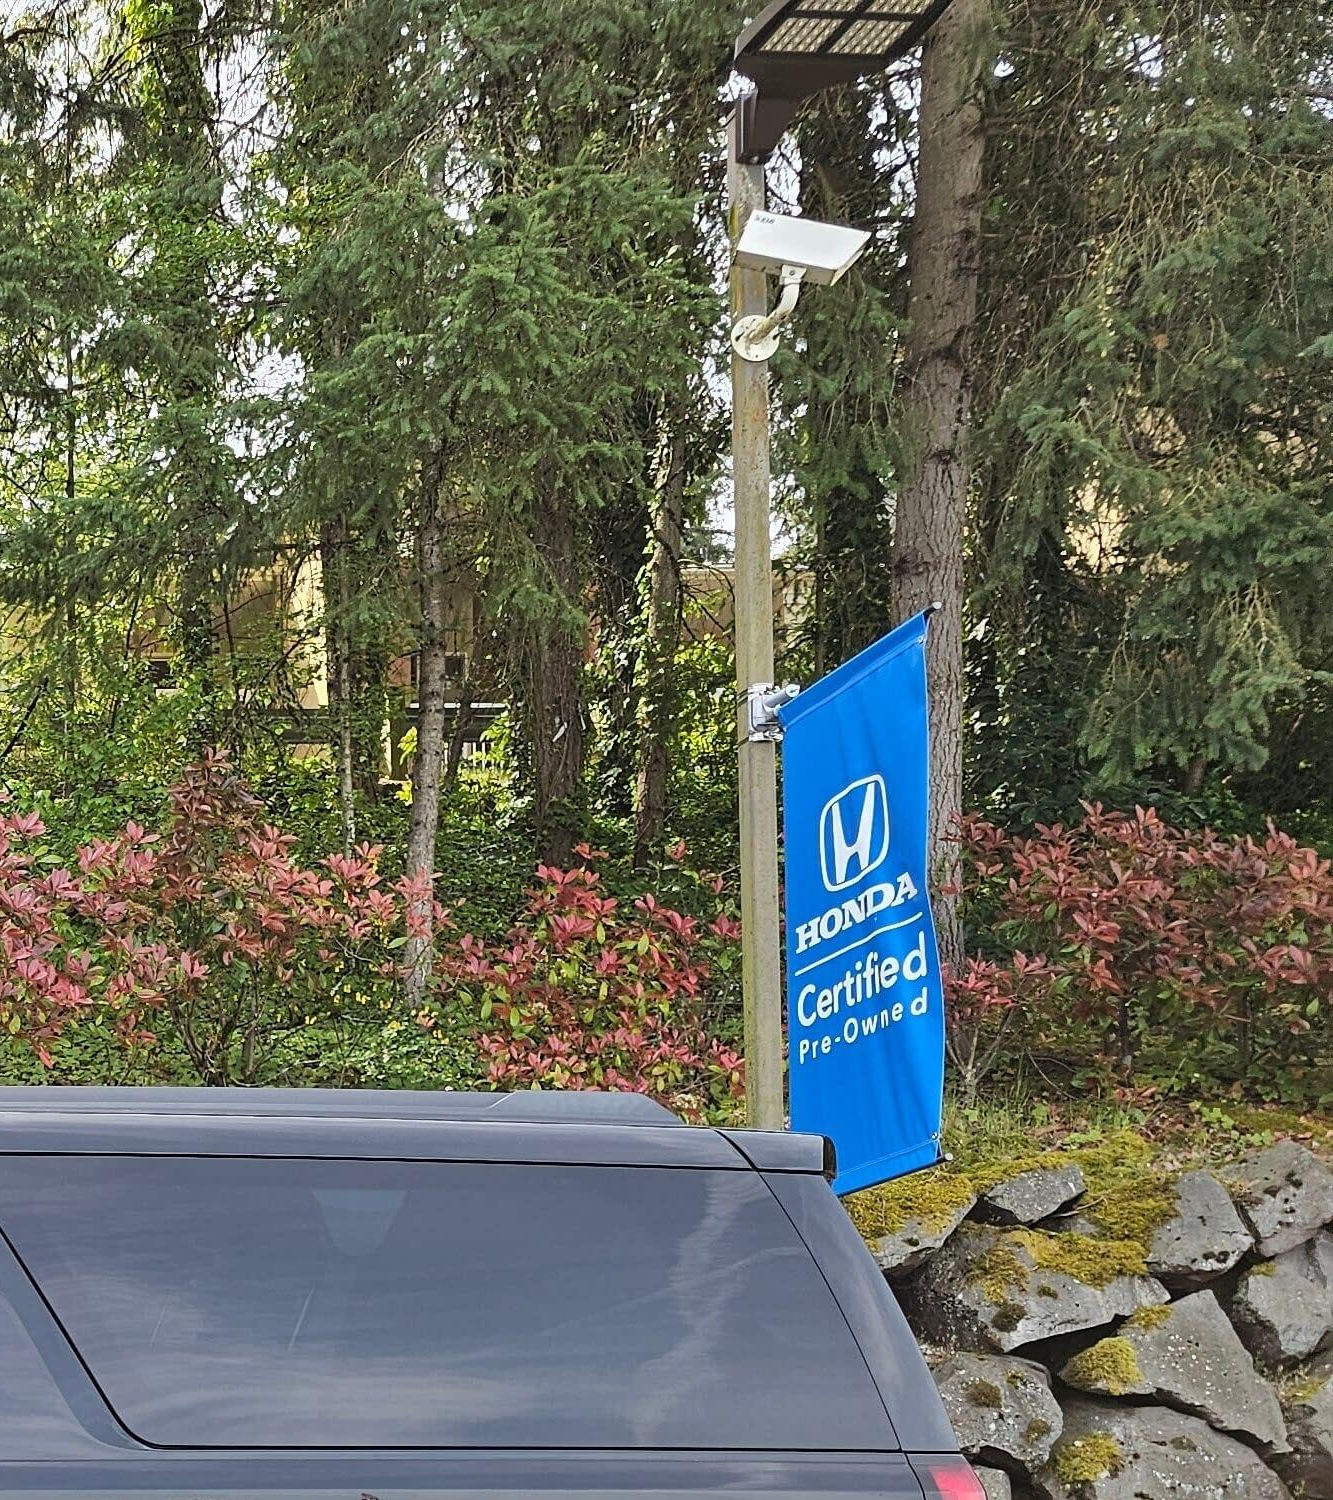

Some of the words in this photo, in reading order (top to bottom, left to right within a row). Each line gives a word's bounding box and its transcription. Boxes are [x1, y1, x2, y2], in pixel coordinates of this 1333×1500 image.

[795, 871, 918, 955] HONDA
[797, 930, 927, 1027] Certified
[799, 986, 928, 1065] Pre-Owned
